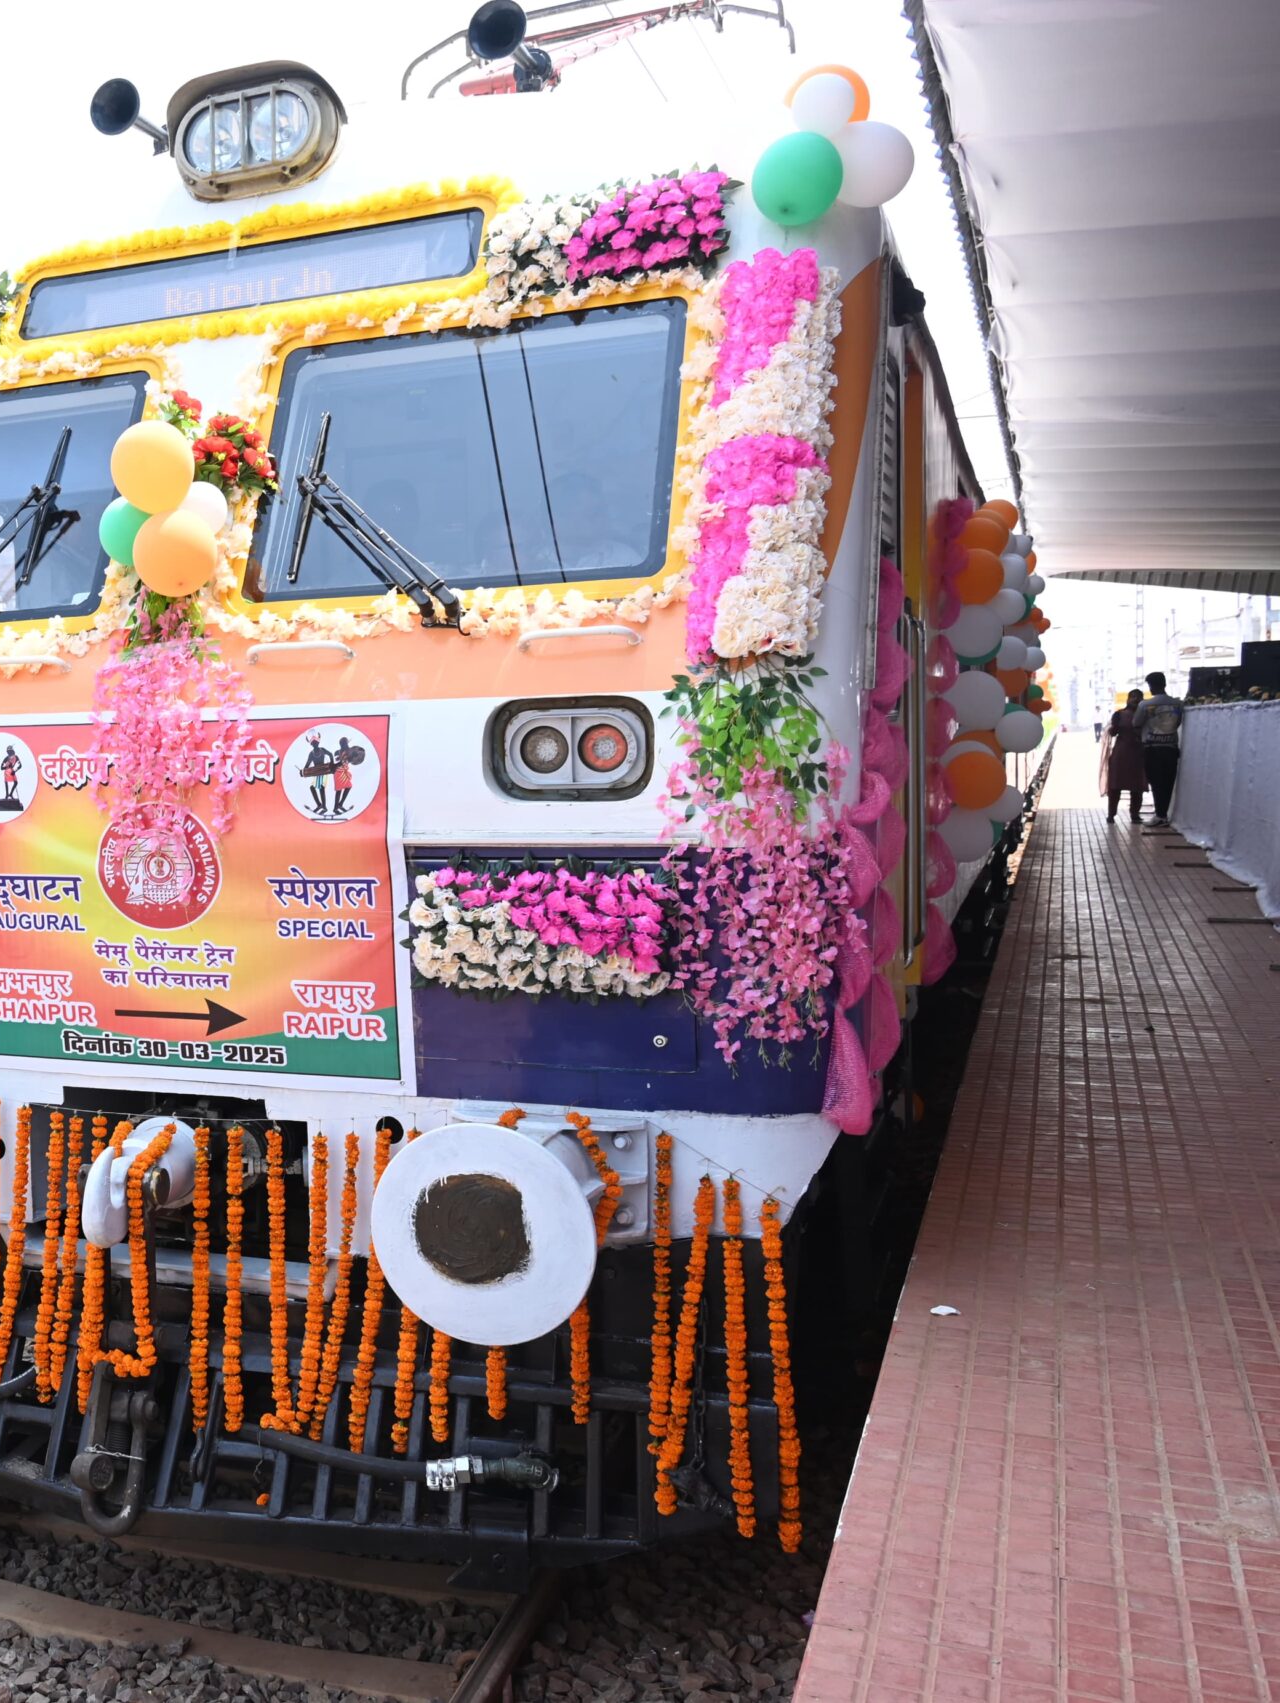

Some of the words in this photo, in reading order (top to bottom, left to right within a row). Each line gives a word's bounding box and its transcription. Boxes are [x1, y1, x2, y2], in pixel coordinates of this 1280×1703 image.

[165, 275, 285, 315] Raipur
[294, 265, 333, 296] Jn
[192, 831, 216, 904] RAILWAYS
[267, 866, 379, 910] स्पेशल
[277, 919, 374, 939] SPECIAL
[94, 938, 131, 967] मेमू
[134, 936, 199, 963] पैसेंजर
[203, 942, 235, 967] ट्रेन
[102, 969, 128, 985] का
[134, 965, 230, 989] परिचालन
[293, 983, 372, 1014] रायपुर
[286, 1014, 384, 1038] RAIPUR
[63, 1030, 132, 1056] दिनांक
[138, 1039, 286, 1065] 30-03-2025
